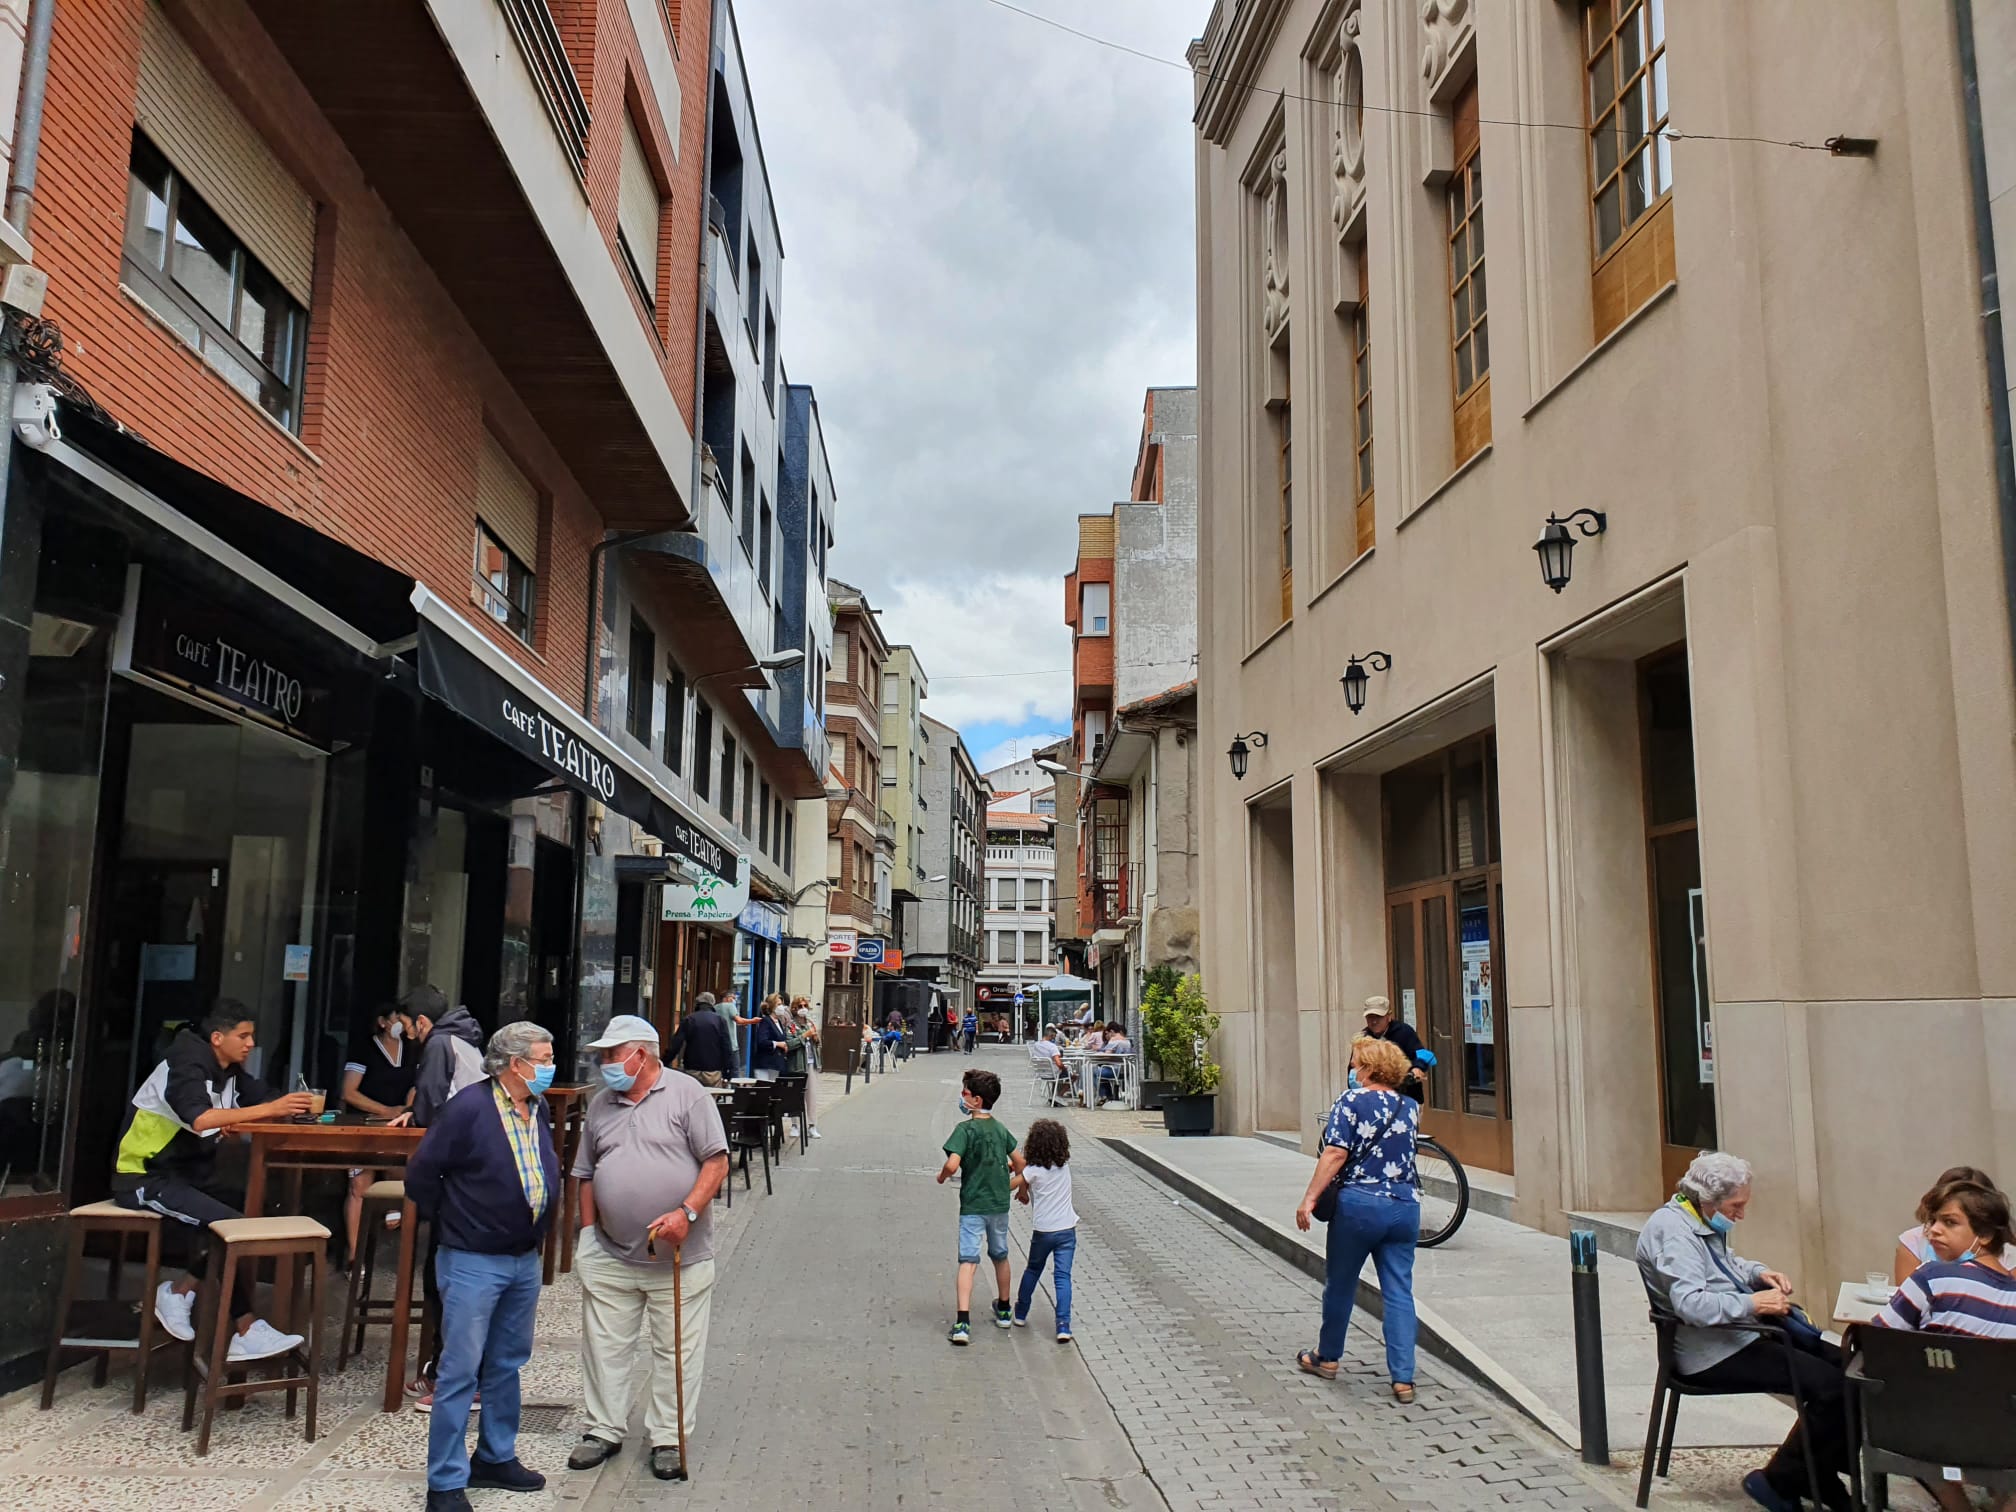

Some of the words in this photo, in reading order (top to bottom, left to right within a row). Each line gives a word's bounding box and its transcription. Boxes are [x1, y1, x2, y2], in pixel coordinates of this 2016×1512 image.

[177, 634, 210, 667] CAFÉ
[216, 637, 301, 724] TEATRO
[503, 699, 536, 739] CAFÉ
[537, 711, 615, 801] TEATRO
[675, 825, 688, 845] CAFÉ
[689, 828, 721, 873] TEATRO
[665, 909, 692, 918] Prensa
